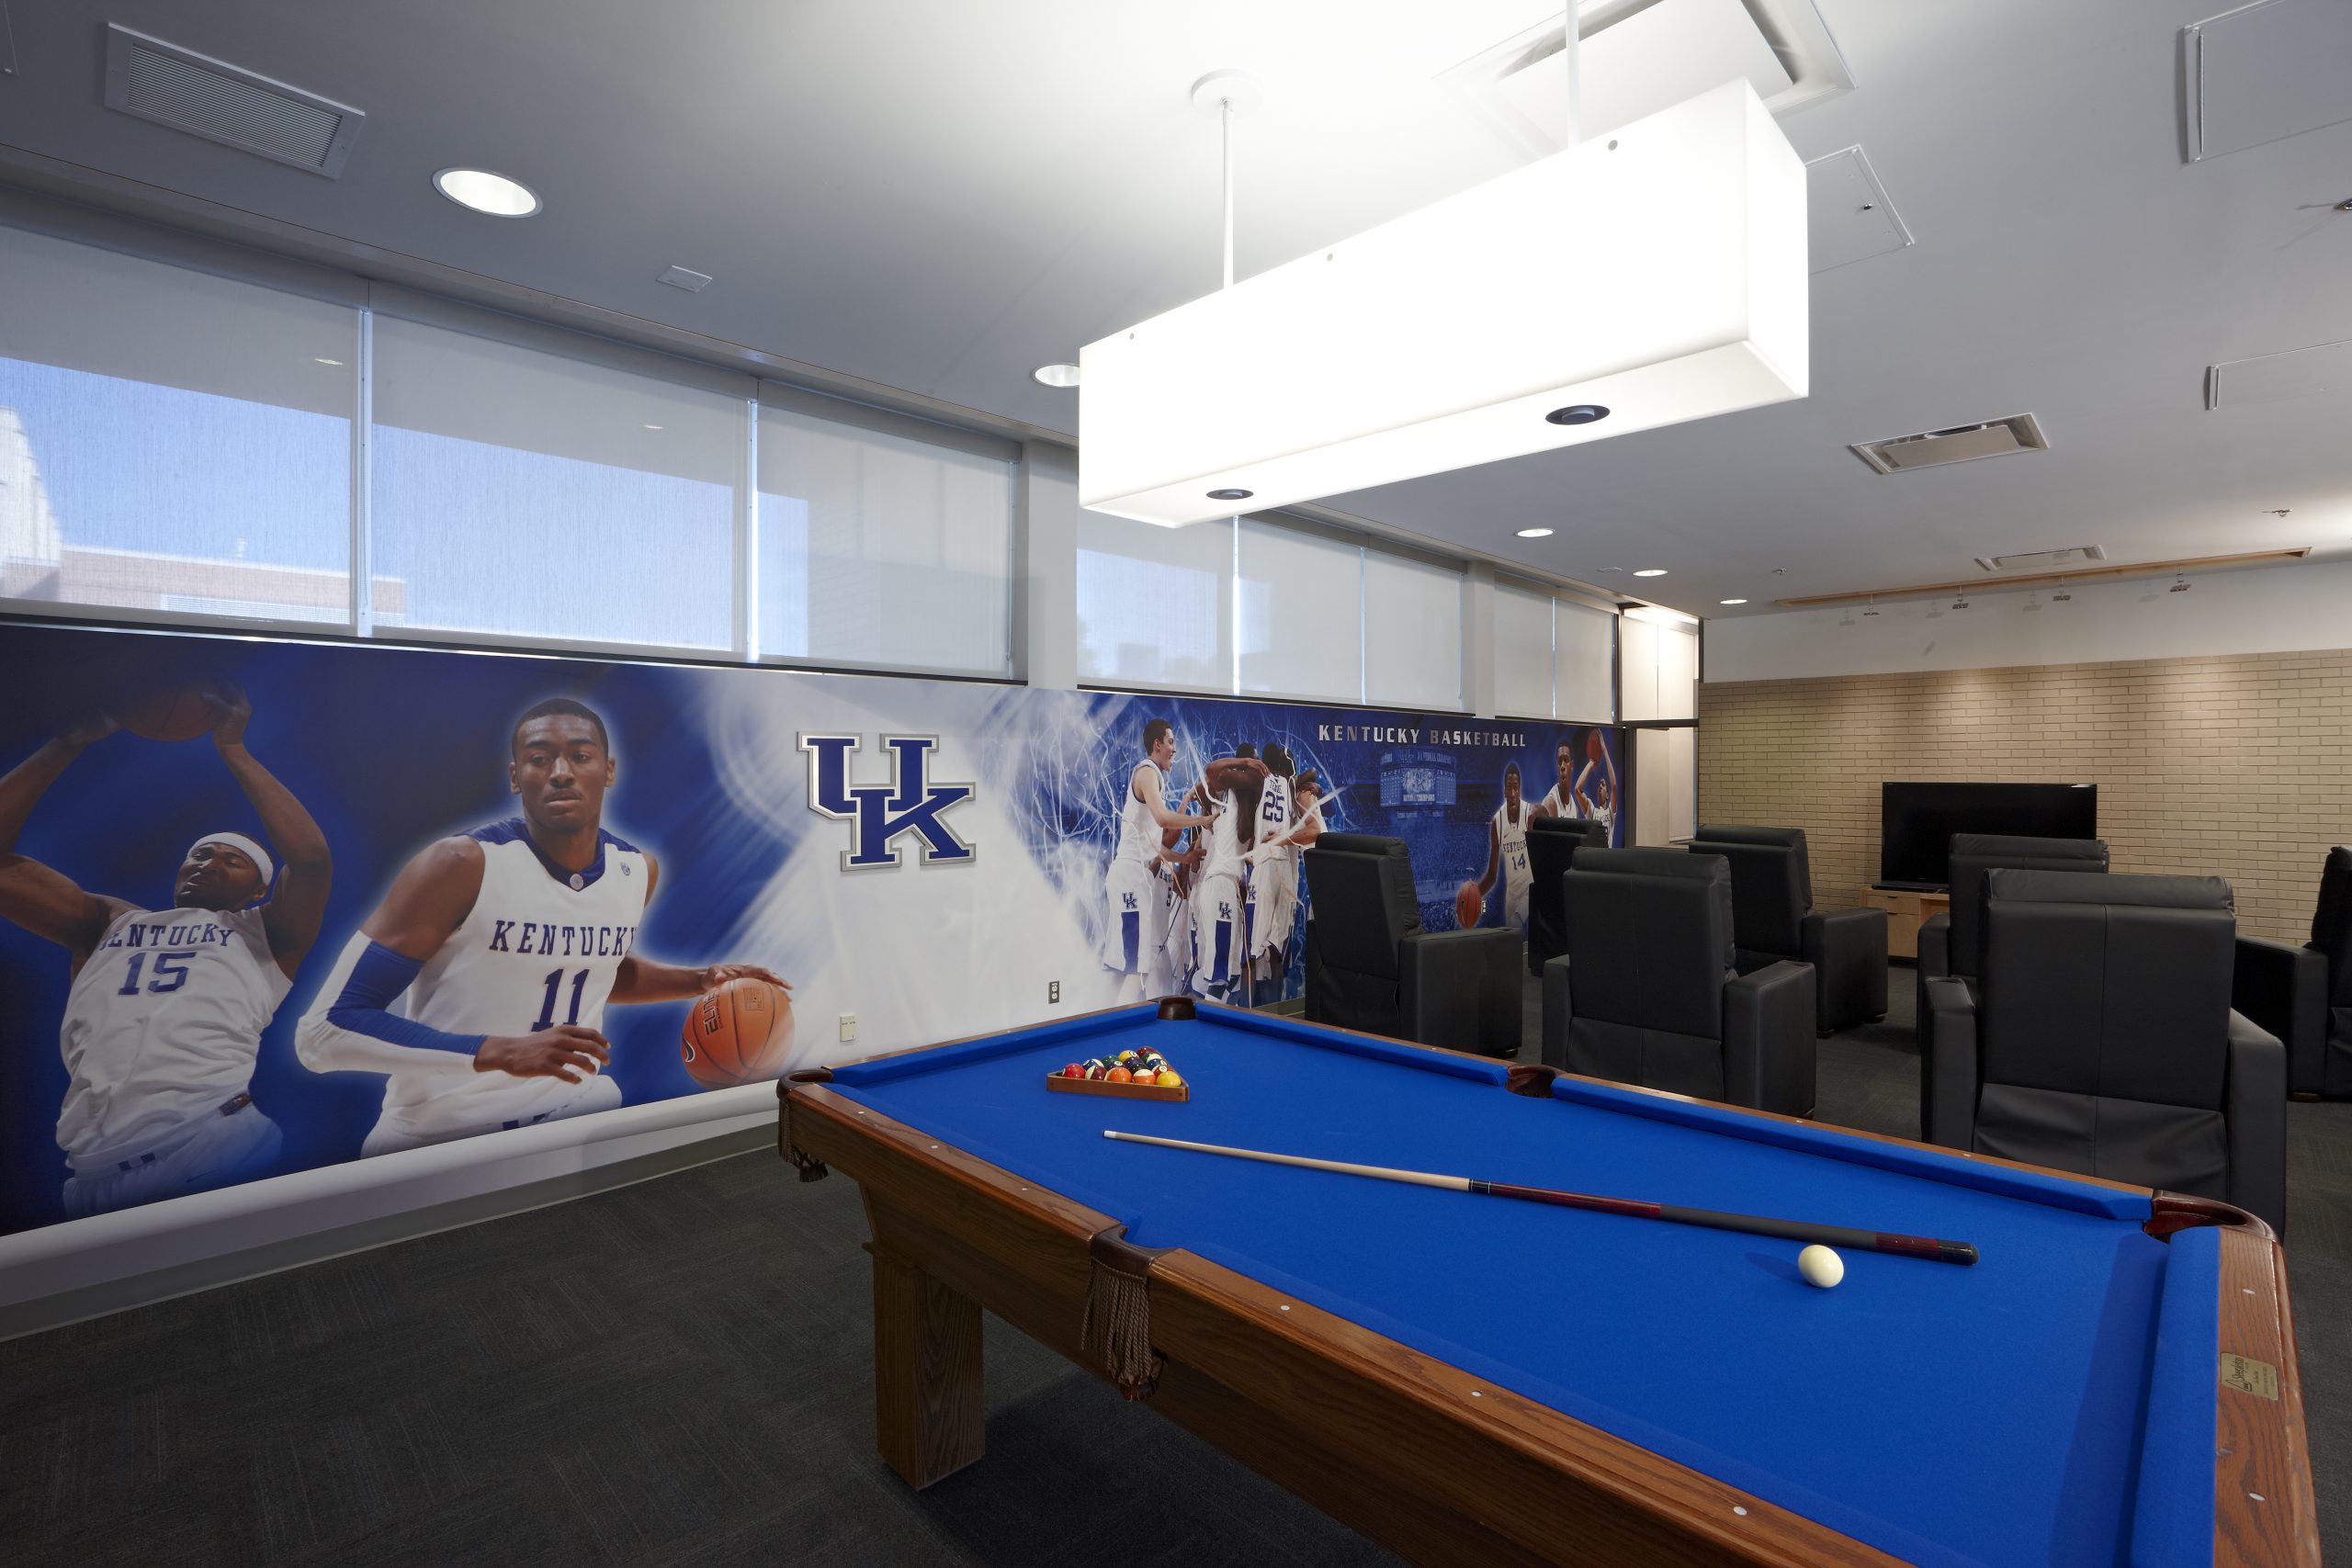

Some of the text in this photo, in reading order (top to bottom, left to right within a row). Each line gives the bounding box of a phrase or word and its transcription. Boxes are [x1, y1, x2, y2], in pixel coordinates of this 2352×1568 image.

[1318, 724, 1526, 747] KENTUCKY BASKETBALL
[797, 731, 976, 872] UK
[1262, 790, 1284, 823] 25
[1511, 853, 1526, 871] 14
[1122, 892, 1138, 910] UK
[1219, 901, 1232, 919] UK
[99, 922, 235, 952] ENTUCKY
[117, 951, 198, 996] 15
[530, 968, 590, 1032] 11
